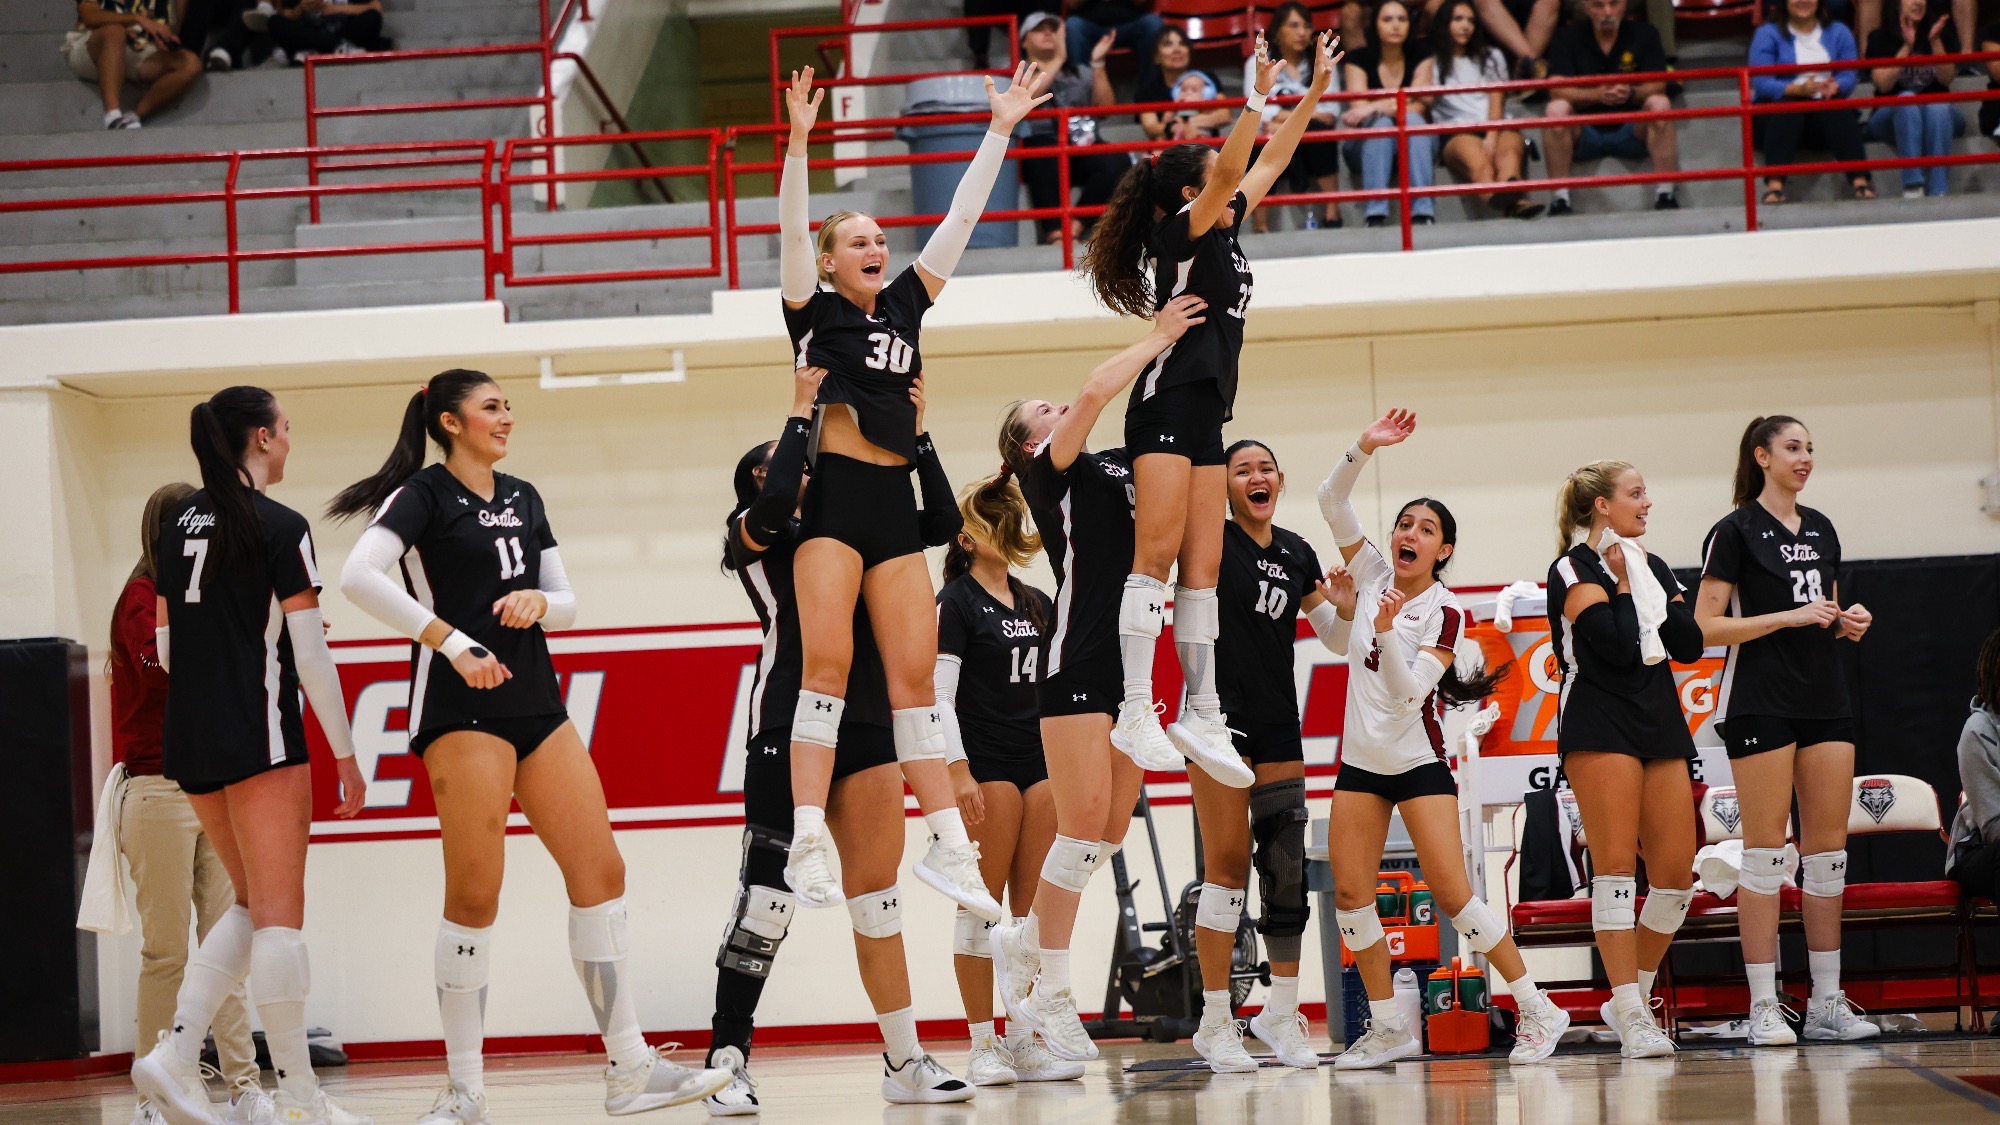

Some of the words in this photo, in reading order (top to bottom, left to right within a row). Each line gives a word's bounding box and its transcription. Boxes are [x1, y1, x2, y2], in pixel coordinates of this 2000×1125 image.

[841, 96, 854, 118] F
[865, 332, 914, 374] 30
[177, 506, 216, 534] Aggie
[478, 507, 523, 528] State
[494, 536, 526, 580] 11
[1780, 543, 1821, 563] State
[182, 538, 209, 604] 7
[1790, 568, 1823, 603] 28
[1255, 580, 1289, 620] 10
[1001, 618, 1040, 638] State
[1009, 646, 1039, 683] 14
[1681, 677, 1714, 714] G
[1380, 859, 1420, 869] RUTE
[1415, 904, 1431, 922] G
[1385, 931, 1405, 955] G
